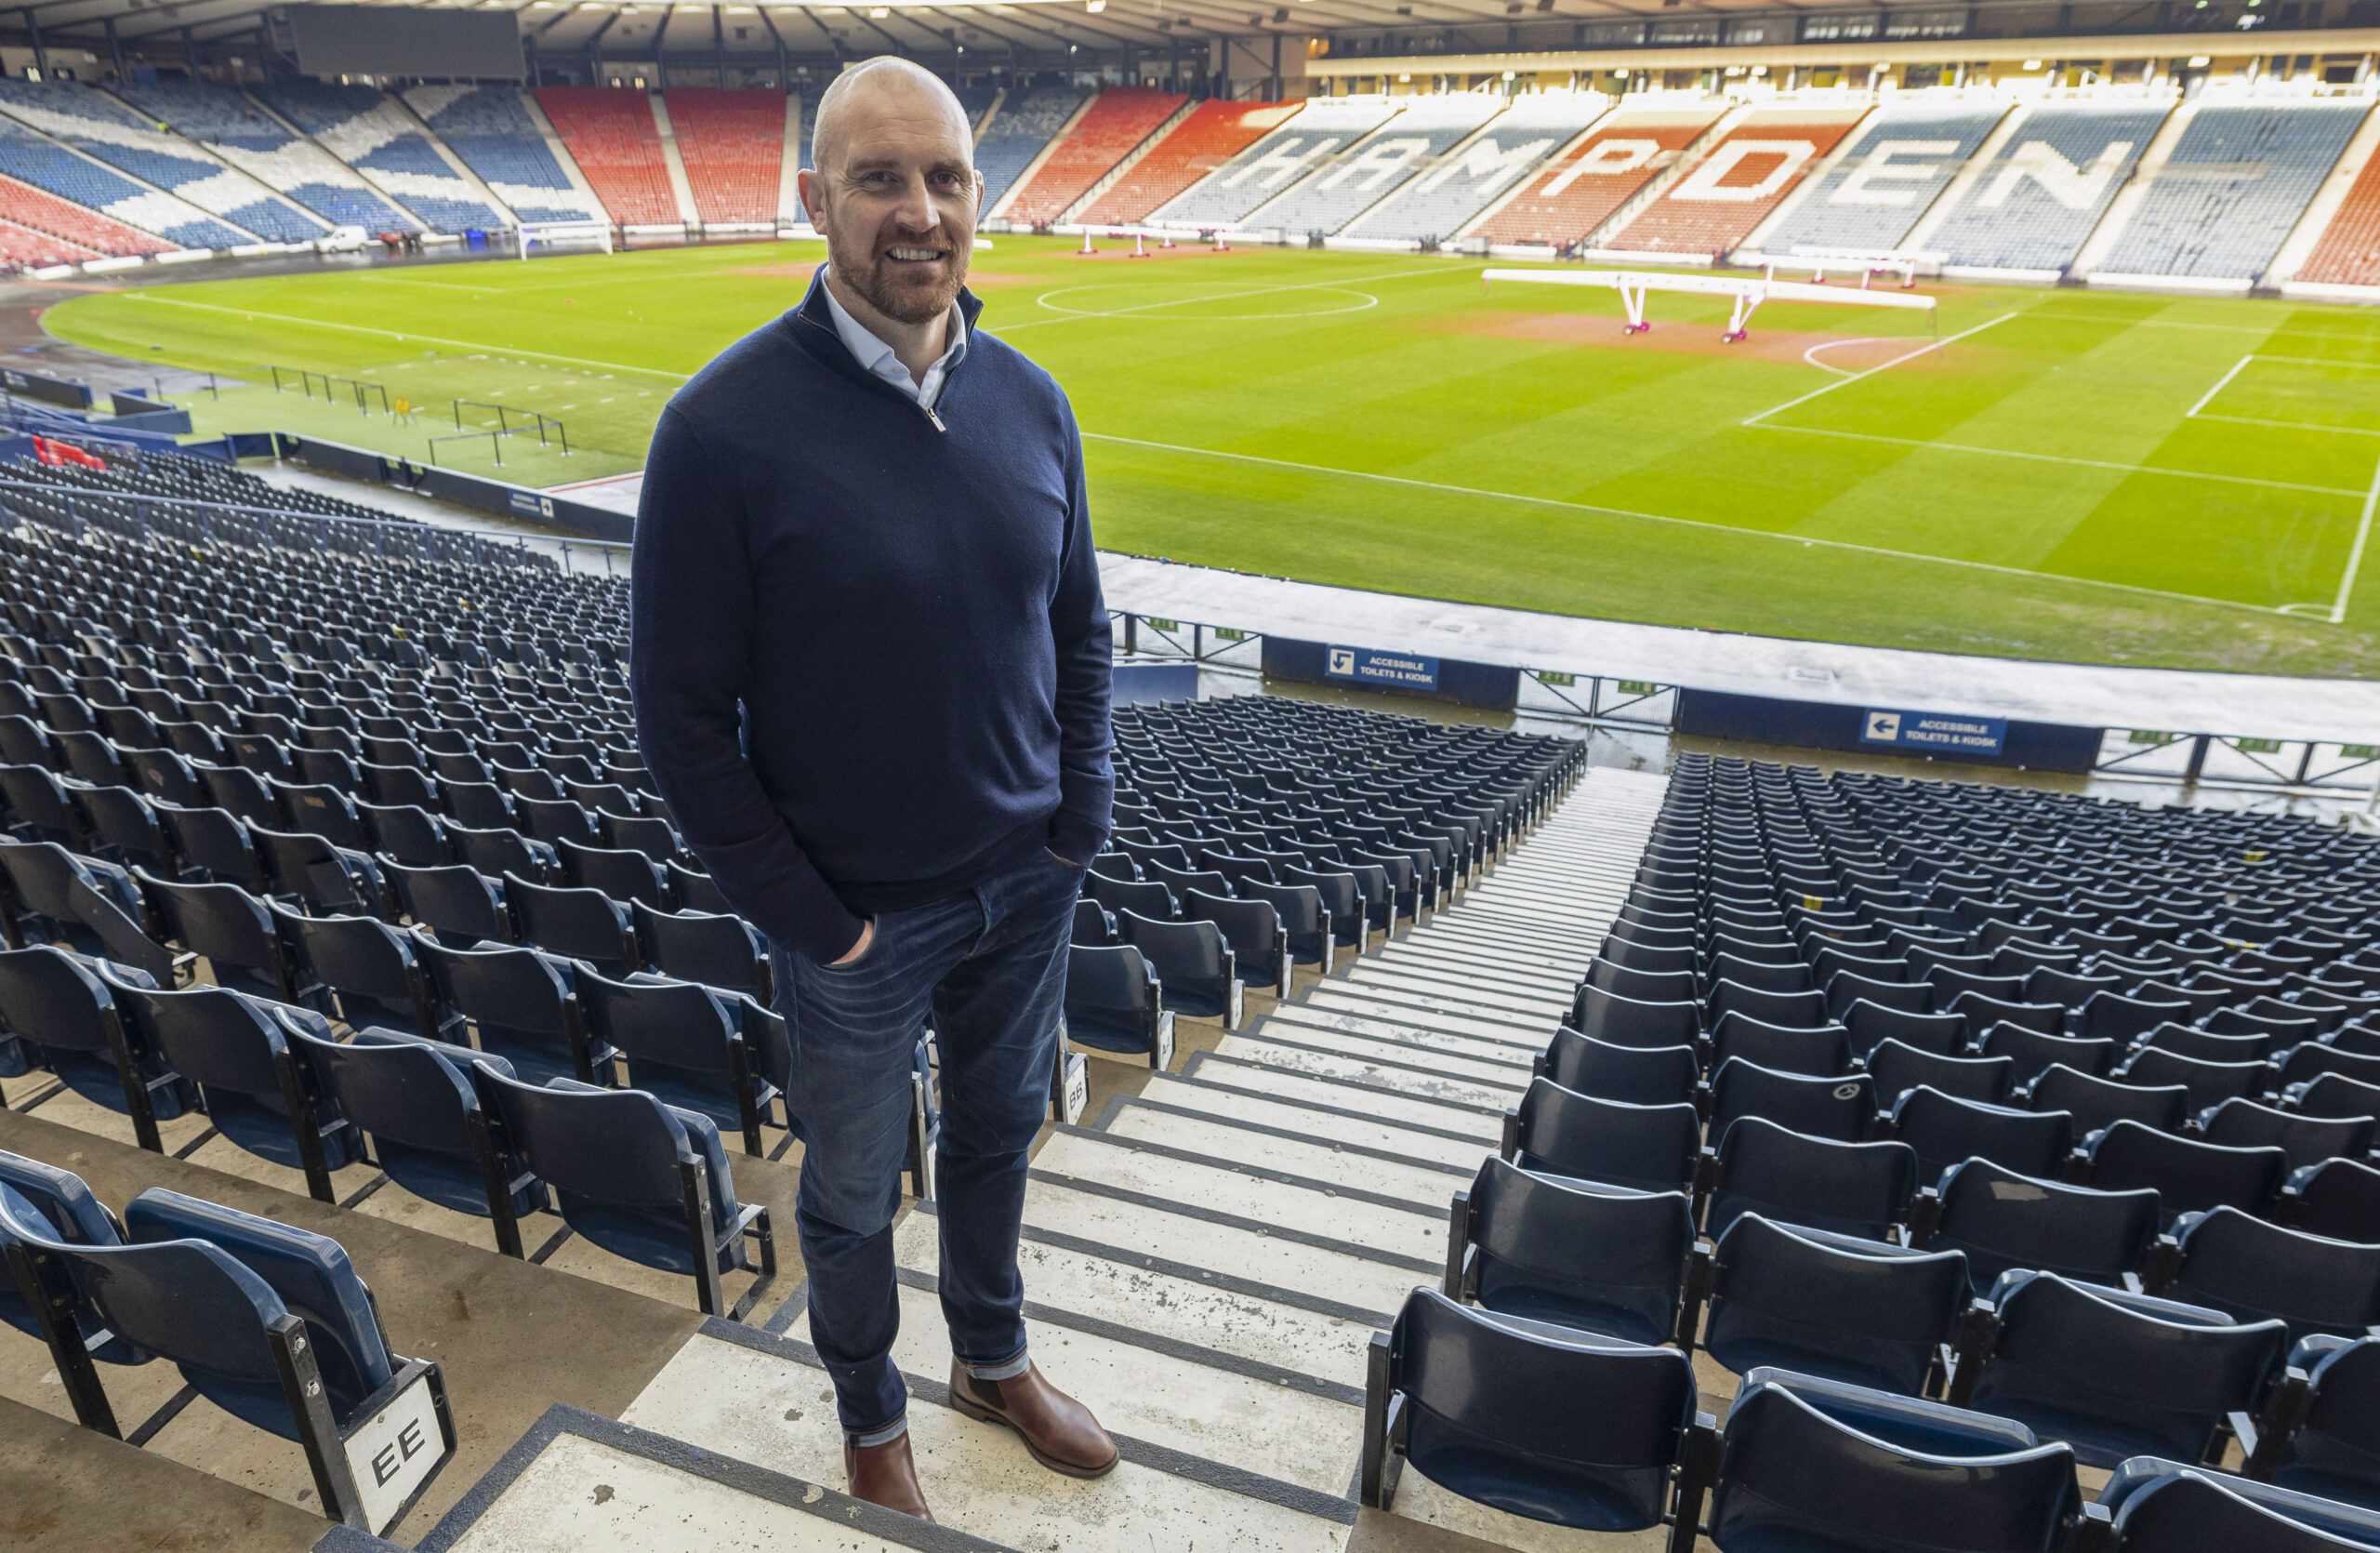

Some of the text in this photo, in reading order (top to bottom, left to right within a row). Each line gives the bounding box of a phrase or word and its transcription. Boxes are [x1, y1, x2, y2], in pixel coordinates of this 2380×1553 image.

[1221, 137, 2135, 210] HAMPDEN
[1369, 657, 1424, 671] ACCESSIBLE
[1360, 666, 1433, 684] TOILETS & KIOSK
[1918, 719, 1989, 735] ACCESSIBLE
[1906, 730, 1998, 748] TOILETS & KIOSK
[371, 1417, 426, 1489] EE
